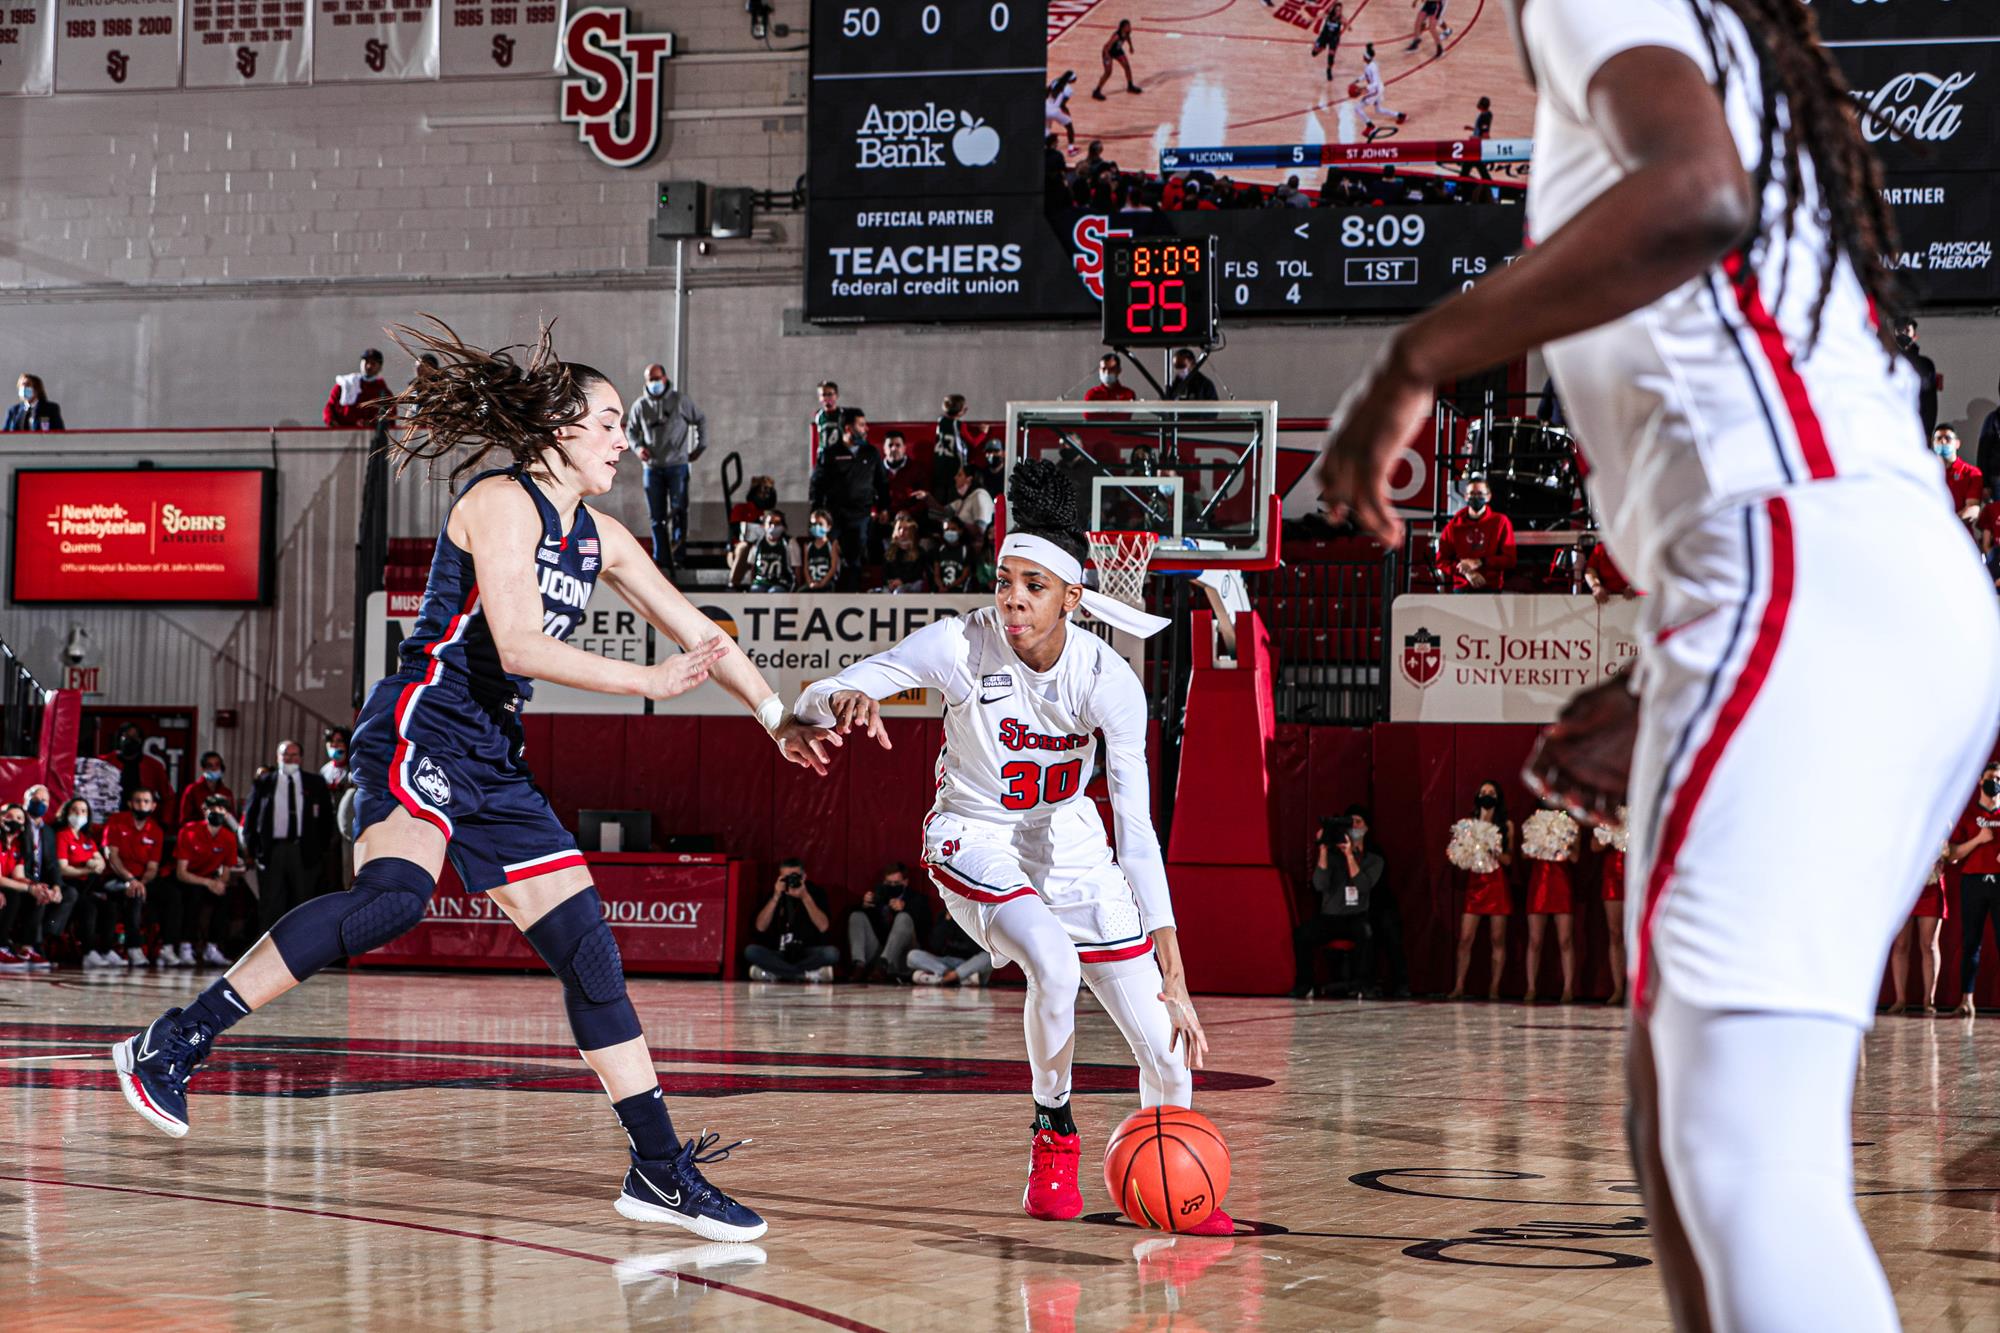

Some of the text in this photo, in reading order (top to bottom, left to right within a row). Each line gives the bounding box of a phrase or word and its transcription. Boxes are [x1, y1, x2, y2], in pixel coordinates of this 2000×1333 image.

[455, 5, 555, 26] 1985 1991 1999
[843, 2, 1009, 37] 50 0 0
[67, 16, 172, 38] 1983 1986 2000
[856, 102, 956, 141] Apple
[856, 137, 946, 168] Bank
[1196, 152, 1233, 163] UCONN
[1292, 147, 1304, 163] 5
[1452, 143, 1464, 159] 2
[1497, 144, 1513, 156] 1st
[857, 209, 994, 228] OFFICIAL PARTNER
[1341, 214, 1425, 247] 8:09
[1928, 241, 1992, 256] PHYSICAL
[829, 244, 1022, 275] TEACHERS
[1134, 245, 1200, 276] 8:09
[1225, 260, 1313, 278] FLS TOL
[1452, 257, 1487, 275] FLS
[1928, 254, 1991, 270] THERAPY
[1364, 262, 1403, 281] 1ST
[831, 276, 1019, 296] federal credit union
[1235, 283, 1301, 305] 0 4
[1126, 279, 1188, 333] 25
[62, 519, 146, 539] Presbyterian
[60, 541, 102, 554] Queens
[391, 595, 425, 611] MUS
[749, 650, 829, 669] federal
[1455, 634, 1592, 666] ST. JOHN'S
[69, 668, 100, 691] EXIT
[1455, 668, 1590, 685] UNIVERSITY
[1000, 758, 1083, 811] 30
